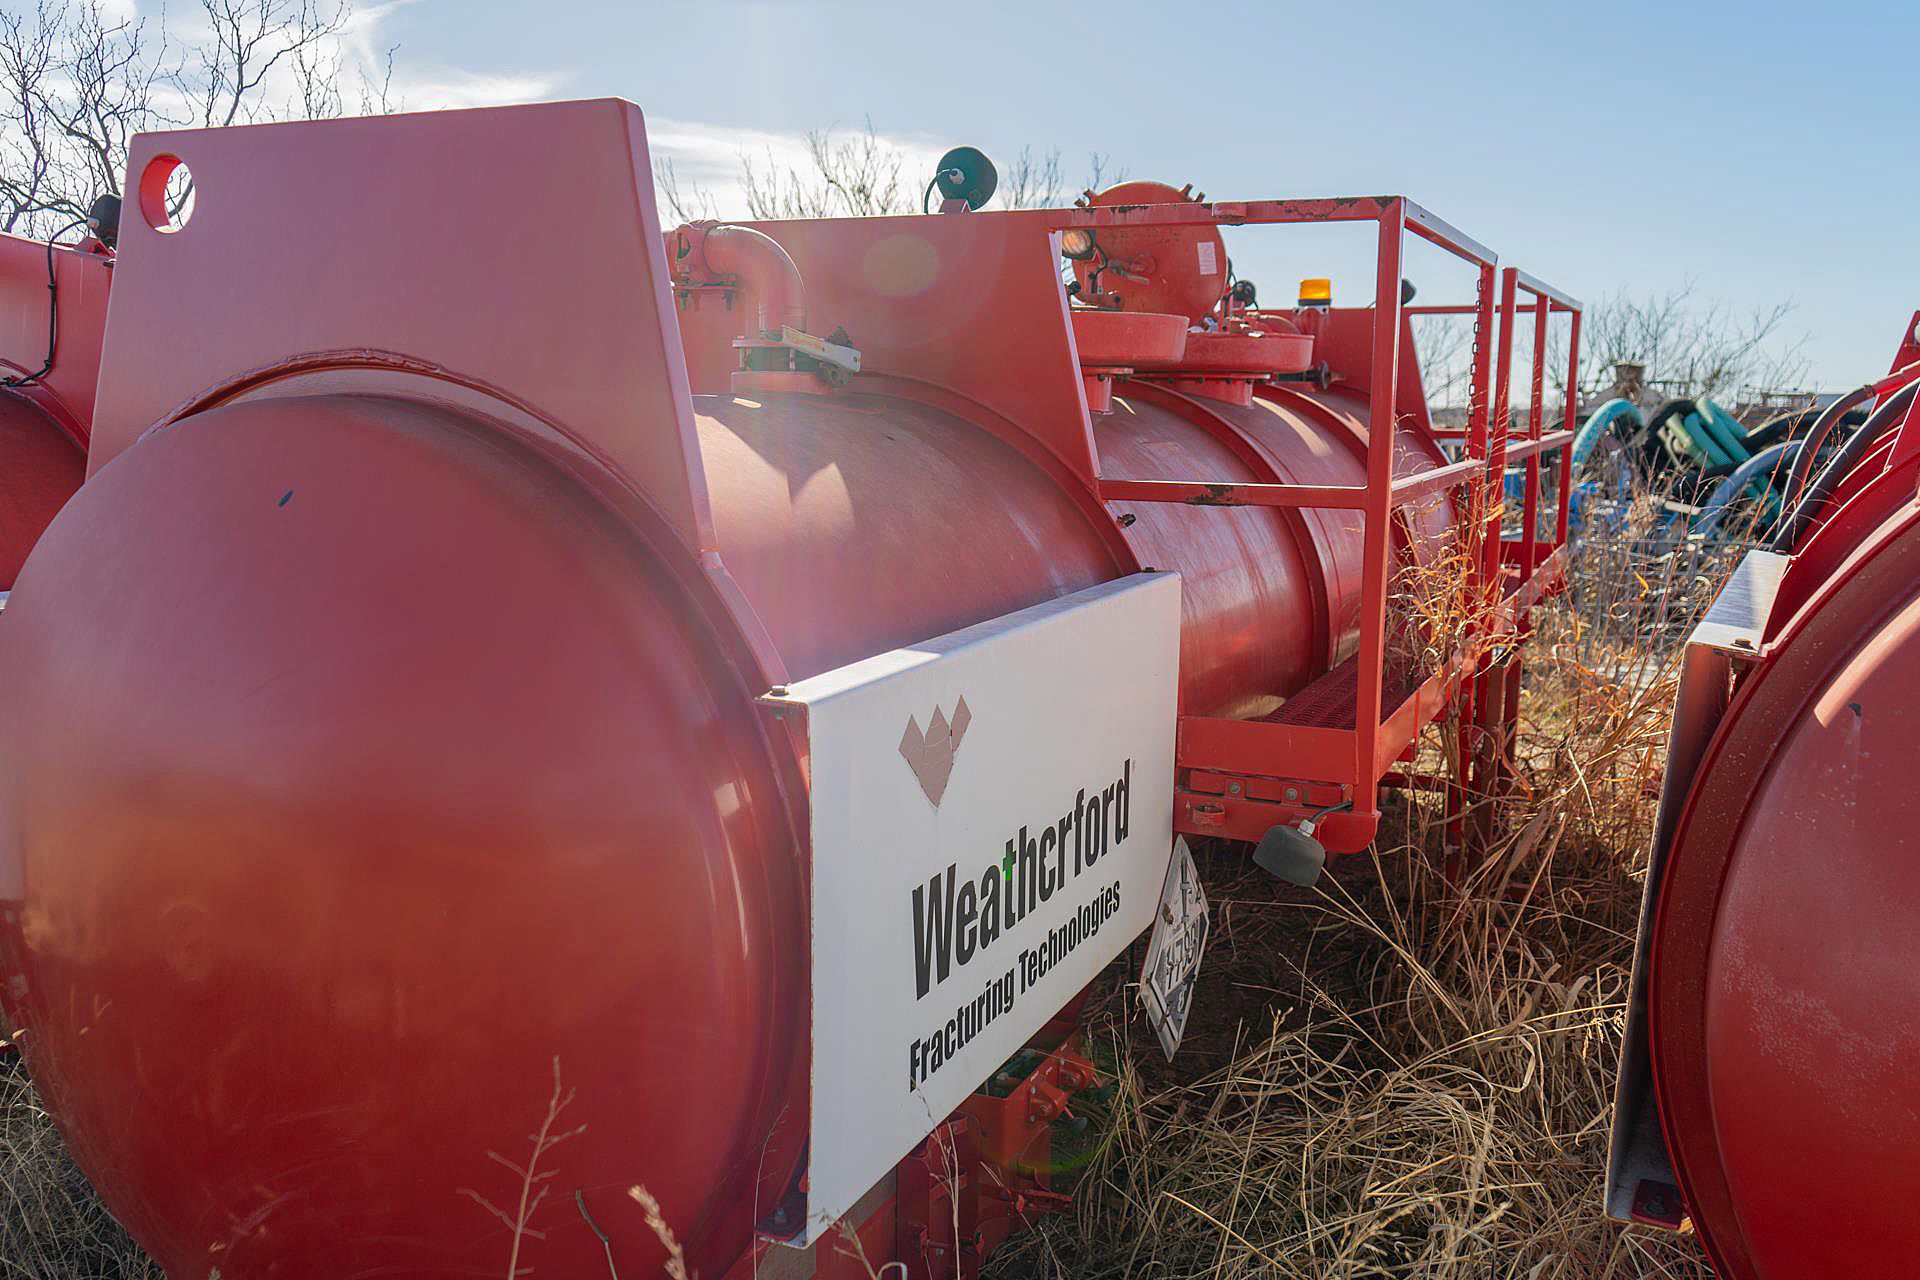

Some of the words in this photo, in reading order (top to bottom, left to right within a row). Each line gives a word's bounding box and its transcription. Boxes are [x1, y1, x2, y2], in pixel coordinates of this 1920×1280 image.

[909, 967, 1015, 1093] Fracturing
[1018, 880, 1121, 995] Technologies
[912, 758, 1130, 1001] Weatherford
